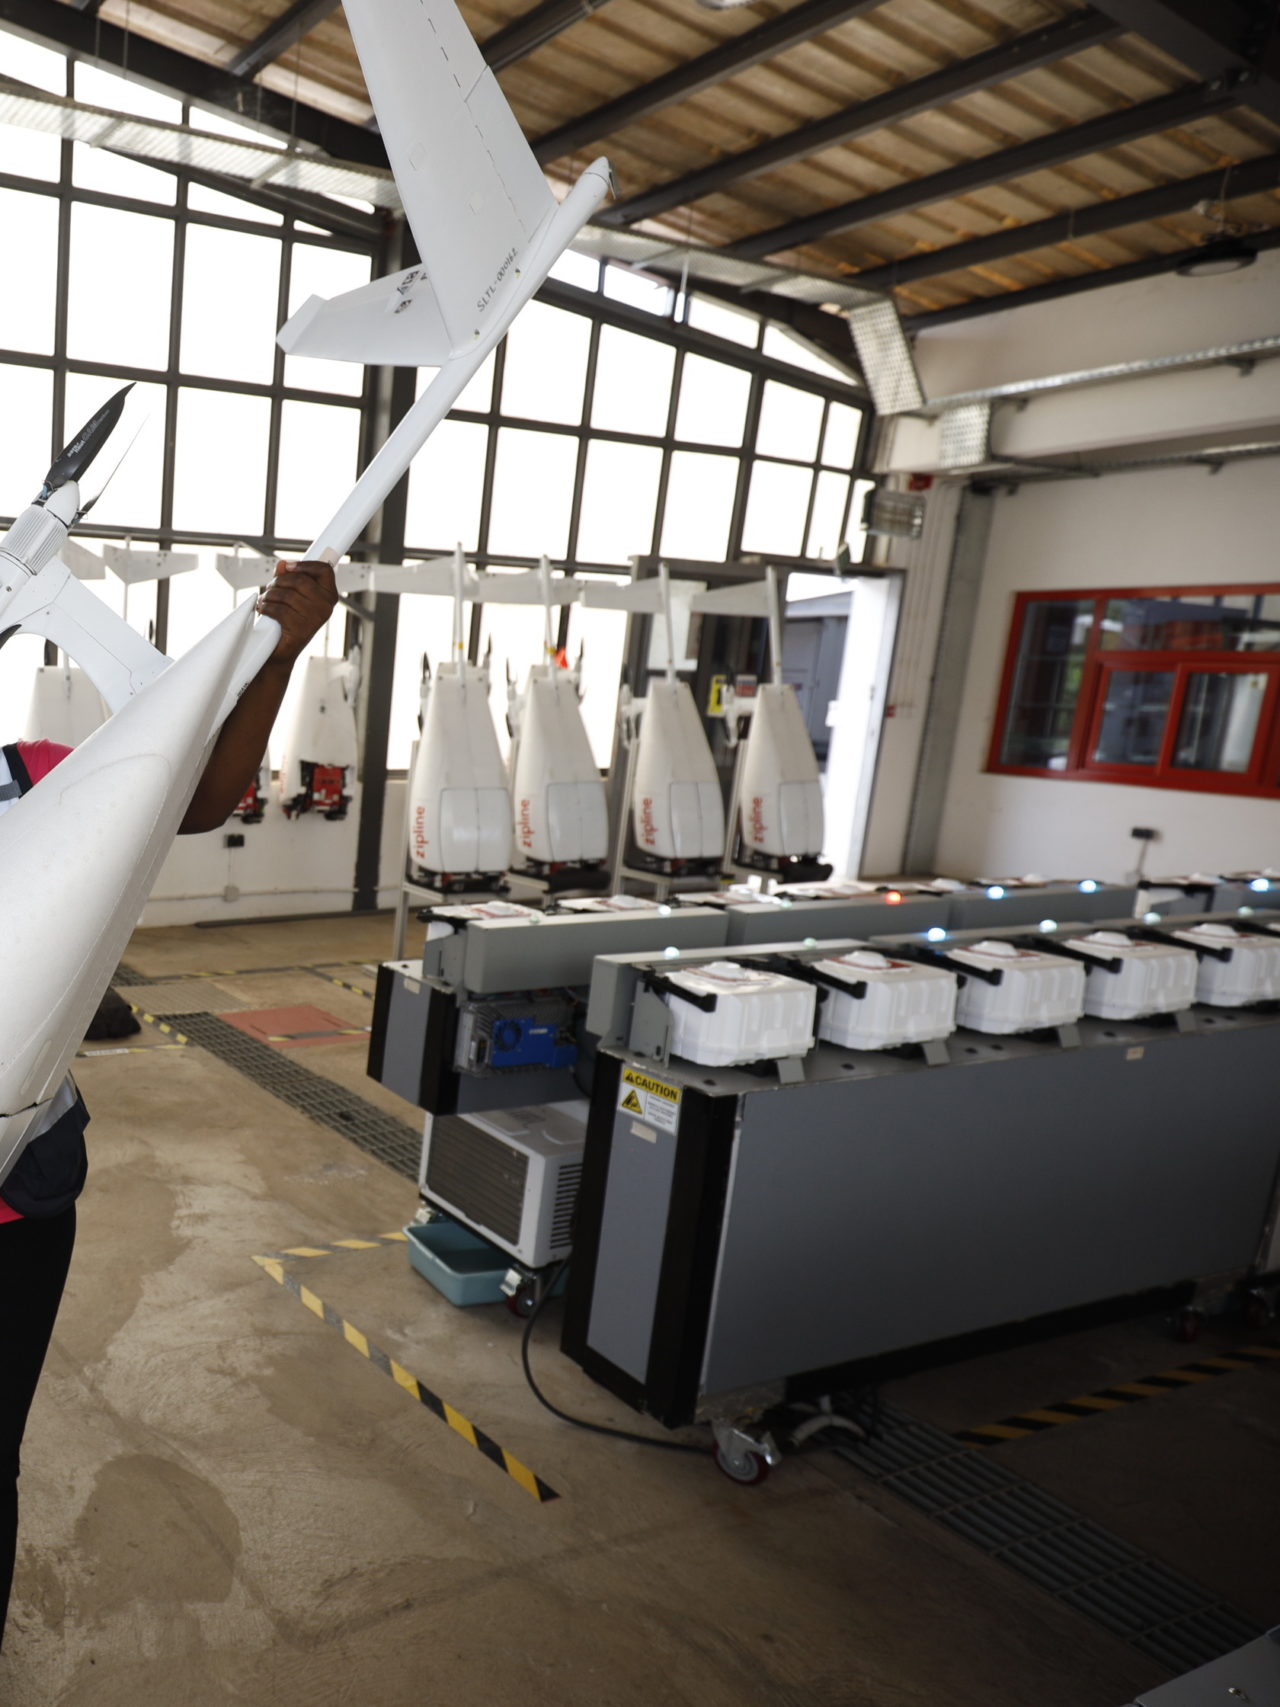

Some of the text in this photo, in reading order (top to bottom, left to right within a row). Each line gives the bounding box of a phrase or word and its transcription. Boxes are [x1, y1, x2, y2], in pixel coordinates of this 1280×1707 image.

[413, 806, 429, 858] zipline
[514, 799, 535, 848] zipline
[640, 797, 658, 846] zipline
[635, 1075, 678, 1101] CAUTION
